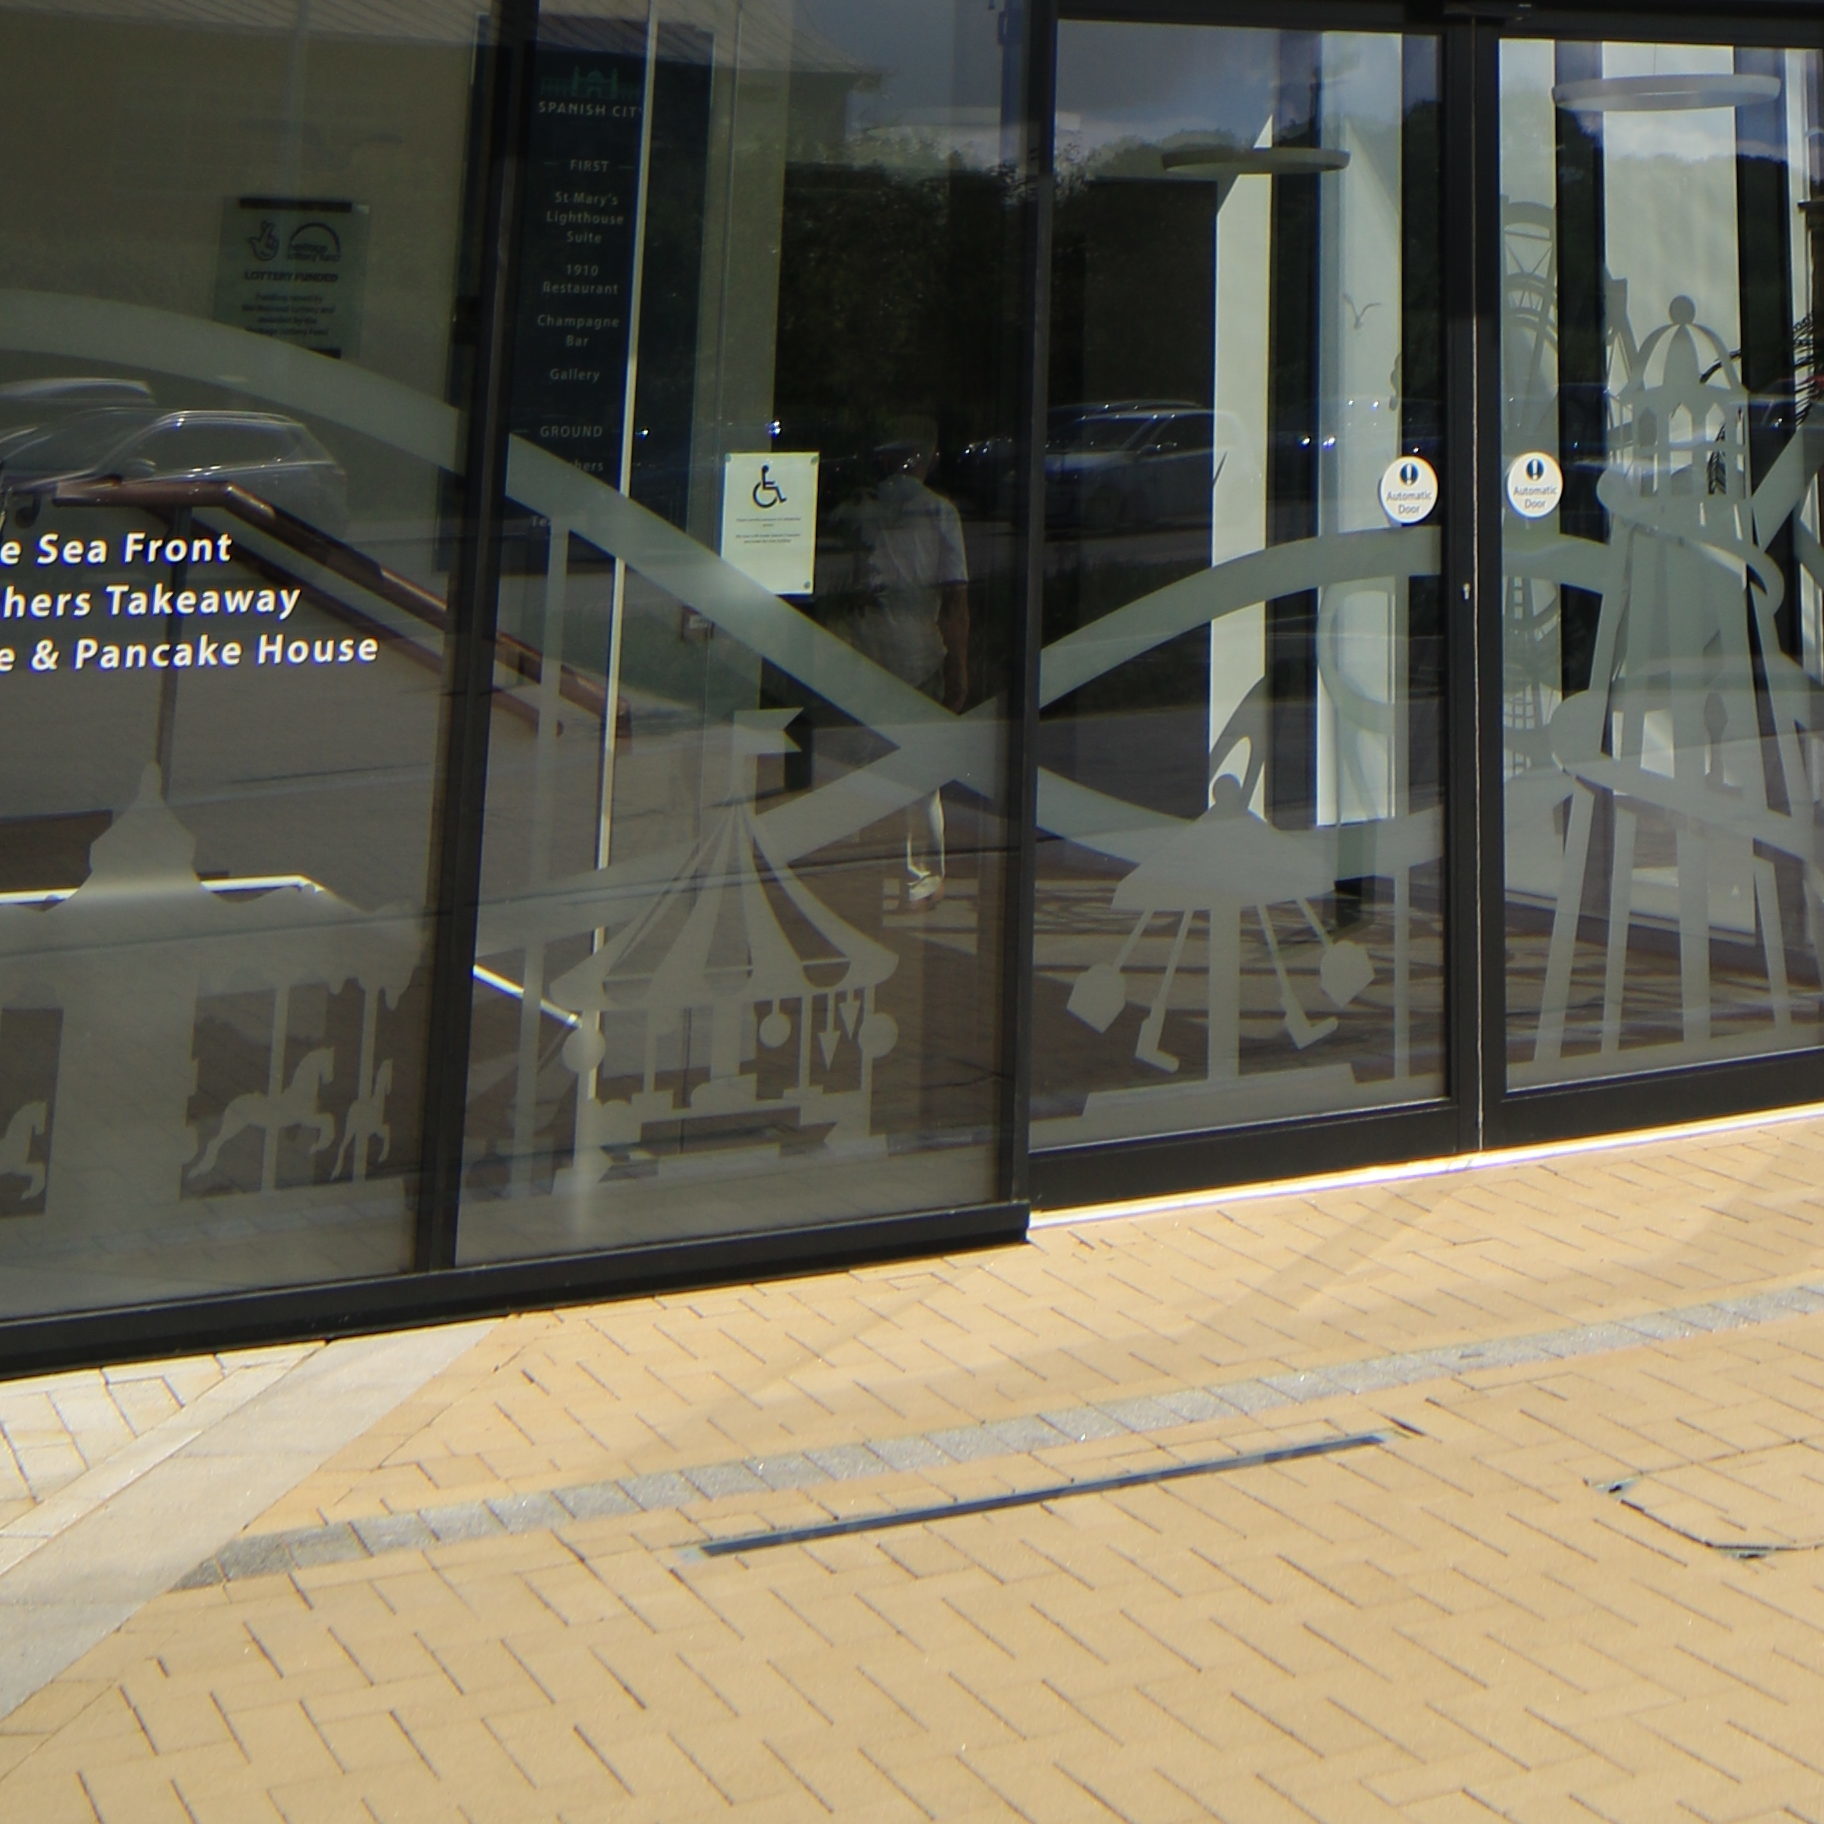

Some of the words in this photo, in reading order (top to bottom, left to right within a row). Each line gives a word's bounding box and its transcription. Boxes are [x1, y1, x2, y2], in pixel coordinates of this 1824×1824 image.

[538, 101, 606, 117] SPANISH
[569, 159, 610, 173] FIRST
[573, 191, 619, 207] Mary's
[545, 210, 625, 226] Lighthouse
[566, 230, 603, 244] Suite
[565, 264, 599, 277] 1910
[542, 281, 619, 295] Restaurant
[537, 314, 620, 330] Champagne
[565, 335, 590, 348] Bar
[549, 368, 601, 383] Gallery
[539, 425, 603, 438] GROUND
[1387, 490, 1432, 501] Automatic
[1514, 486, 1557, 496] Automatic
[1398, 505, 1420, 514] Door
[1524, 499, 1546, 509] Door
[36, 533, 108, 564] Sea
[124, 531, 233, 563] Front
[105, 582, 301, 619] Takeaway
[31, 638, 60, 671] &
[75, 634, 243, 669] Pancake
[257, 633, 379, 664] House
